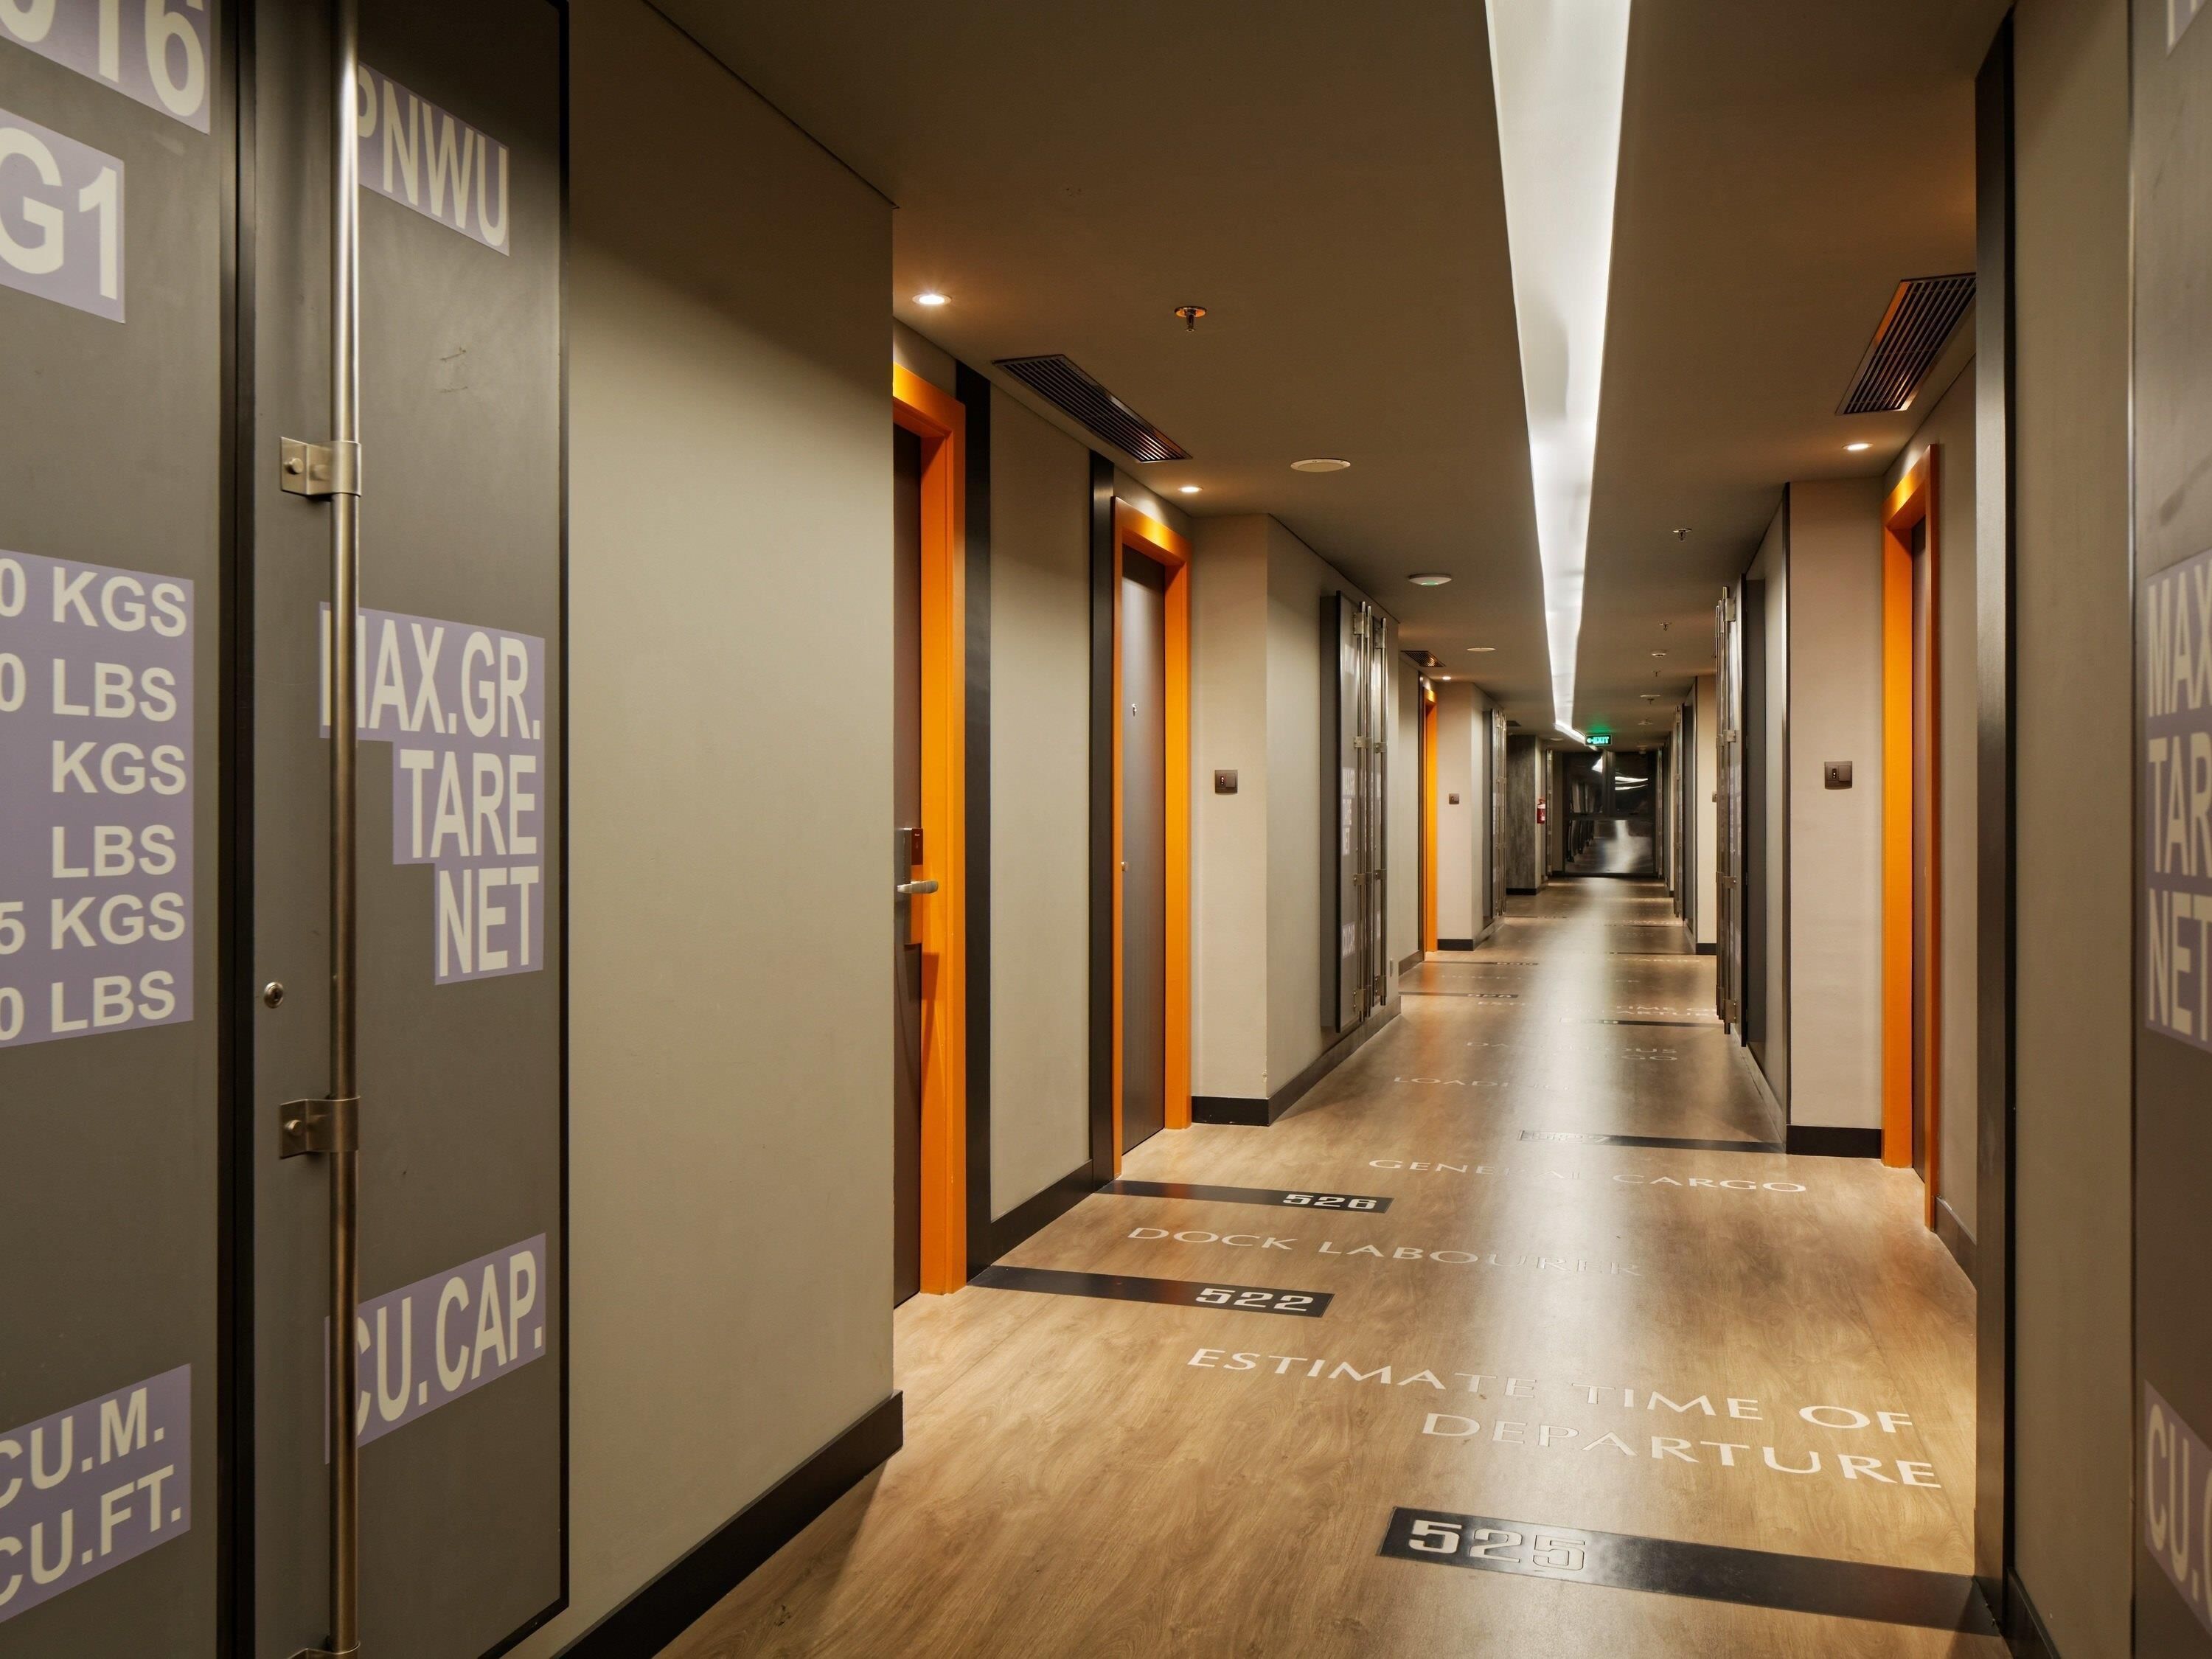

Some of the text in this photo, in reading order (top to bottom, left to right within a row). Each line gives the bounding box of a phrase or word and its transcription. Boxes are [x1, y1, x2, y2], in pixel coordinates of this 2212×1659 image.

[0, 127, 118, 300] G1
[52, 566, 187, 638] KGS
[52, 658, 177, 722] LBS
[52, 740, 187, 795] KGS
[1593, 736, 1610, 744] EXIT
[400, 748, 537, 860] TARE
[52, 824, 177, 879] LBS
[51, 892, 186, 950] KGS
[439, 866, 539, 977] NET
[2149, 888, 2212, 1043] NET
[51, 970, 176, 1033] LBS
[1394, 1077, 1569, 1090] LOADI
[1282, 1193, 1377, 1210] 526
[1613, 1174, 1806, 1192] CARGO
[1127, 1227, 1298, 1251] DOCK
[1195, 1288, 1314, 1312] 522
[1186, 1348, 1913, 1433] ESTIMATE TIME OF
[1422, 1413, 1942, 1489] DEPARTURE
[1408, 1519, 1586, 1571] 525
